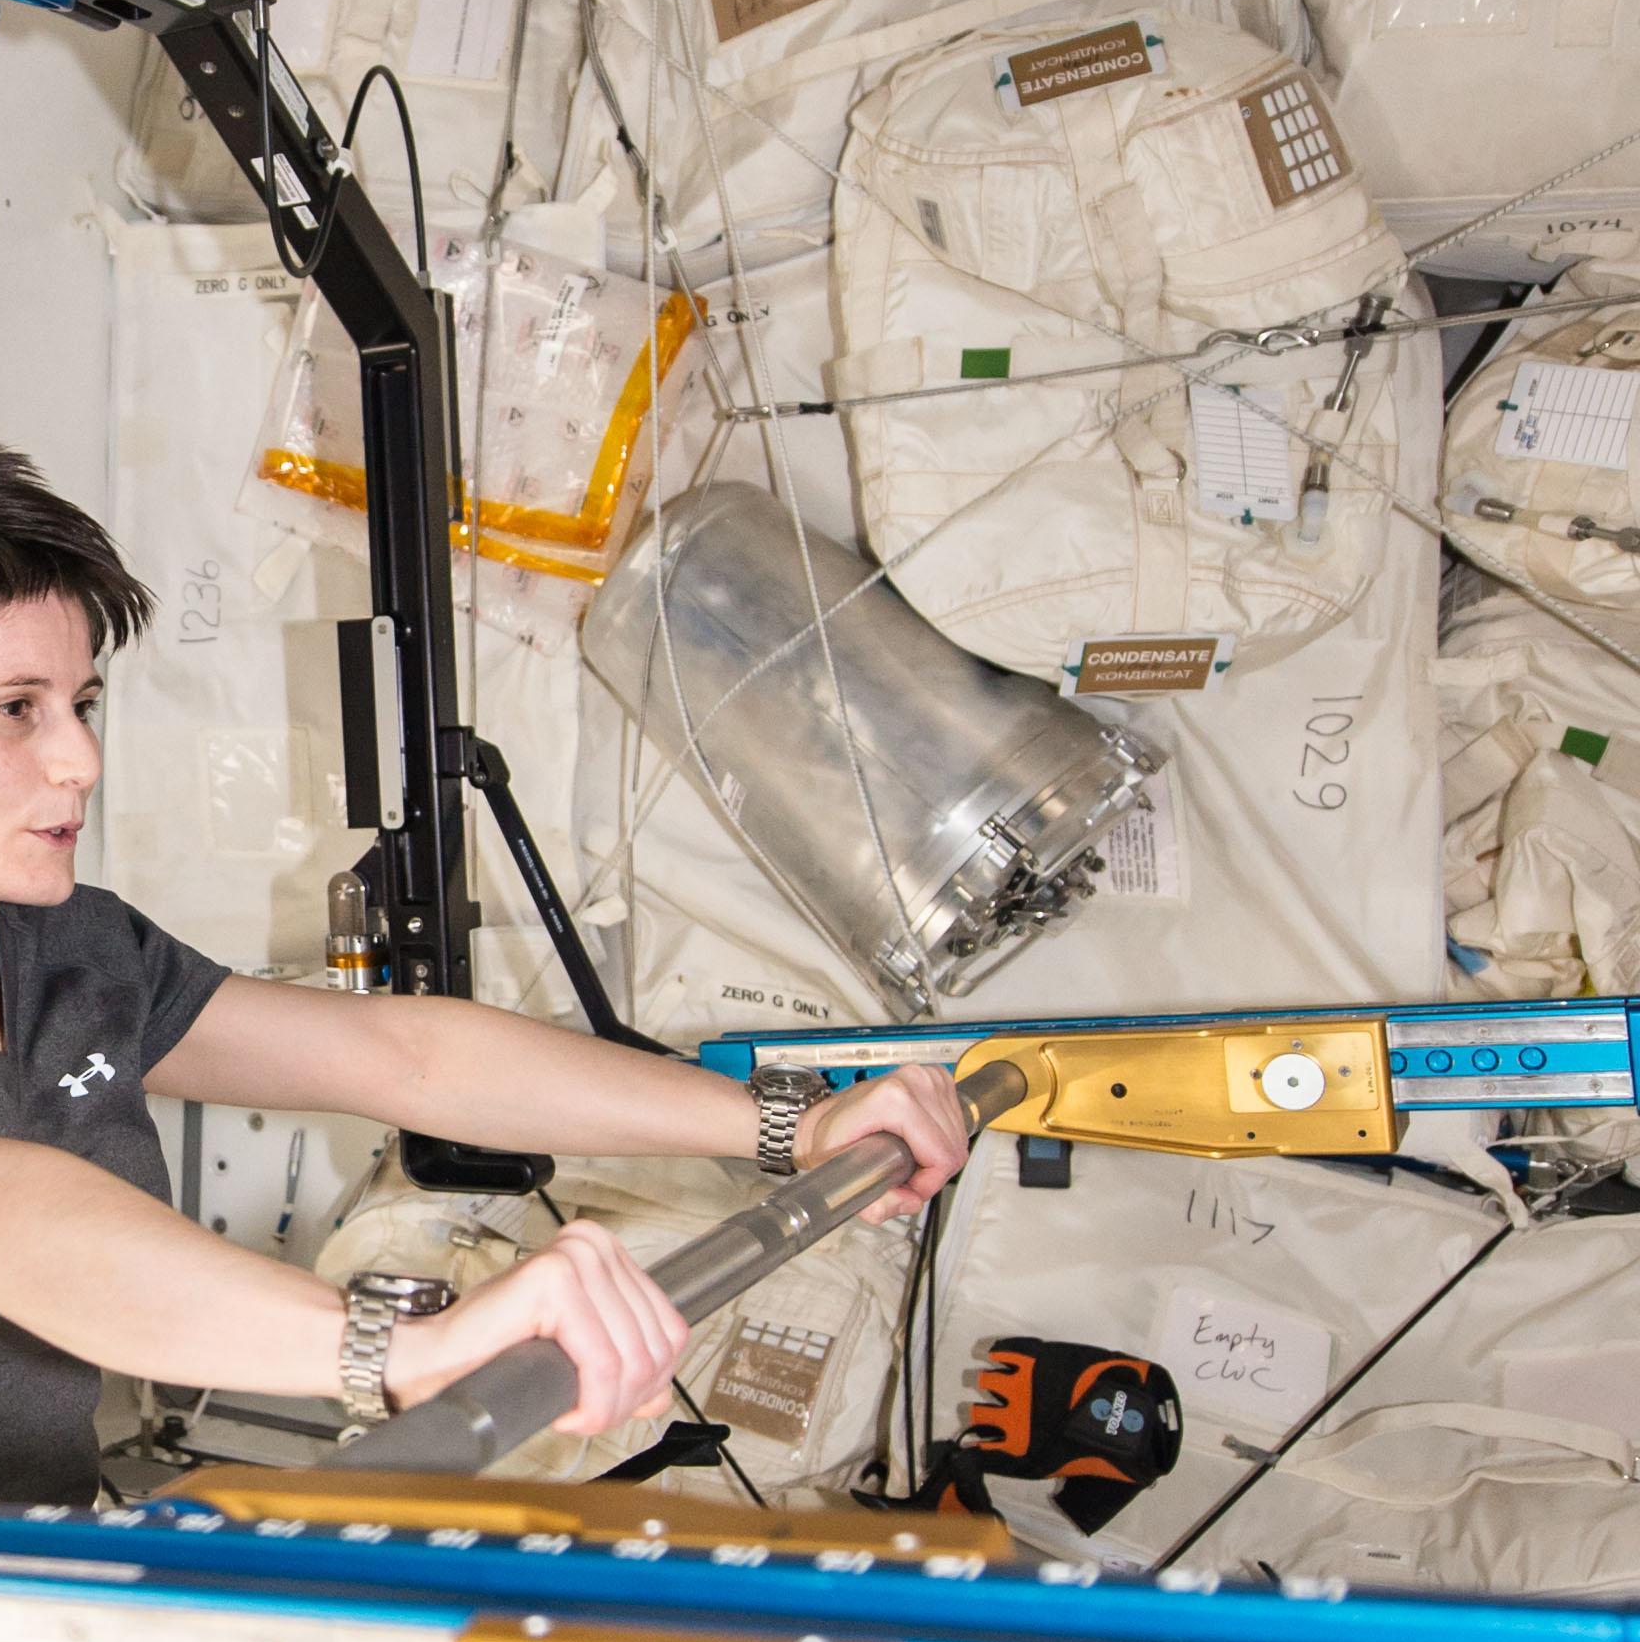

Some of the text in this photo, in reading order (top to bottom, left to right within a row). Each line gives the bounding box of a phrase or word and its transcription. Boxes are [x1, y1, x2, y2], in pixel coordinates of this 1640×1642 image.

[1021, 51, 1144, 95] CONDENSATE
[1547, 219, 1621, 234] 1074
[195, 276, 288, 294] ZERO G ONLY
[179, 559, 221, 643] 1236
[1087, 650, 1210, 666] CONDENSATE
[1096, 669, 1193, 681] КОНДЕНСАТ
[1292, 695, 1363, 811] 1029
[721, 984, 830, 1019] ZERO G ONLY
[1193, 1314, 1275, 1359] Empty
[716, 1378, 810, 1417] CONDENSATE
